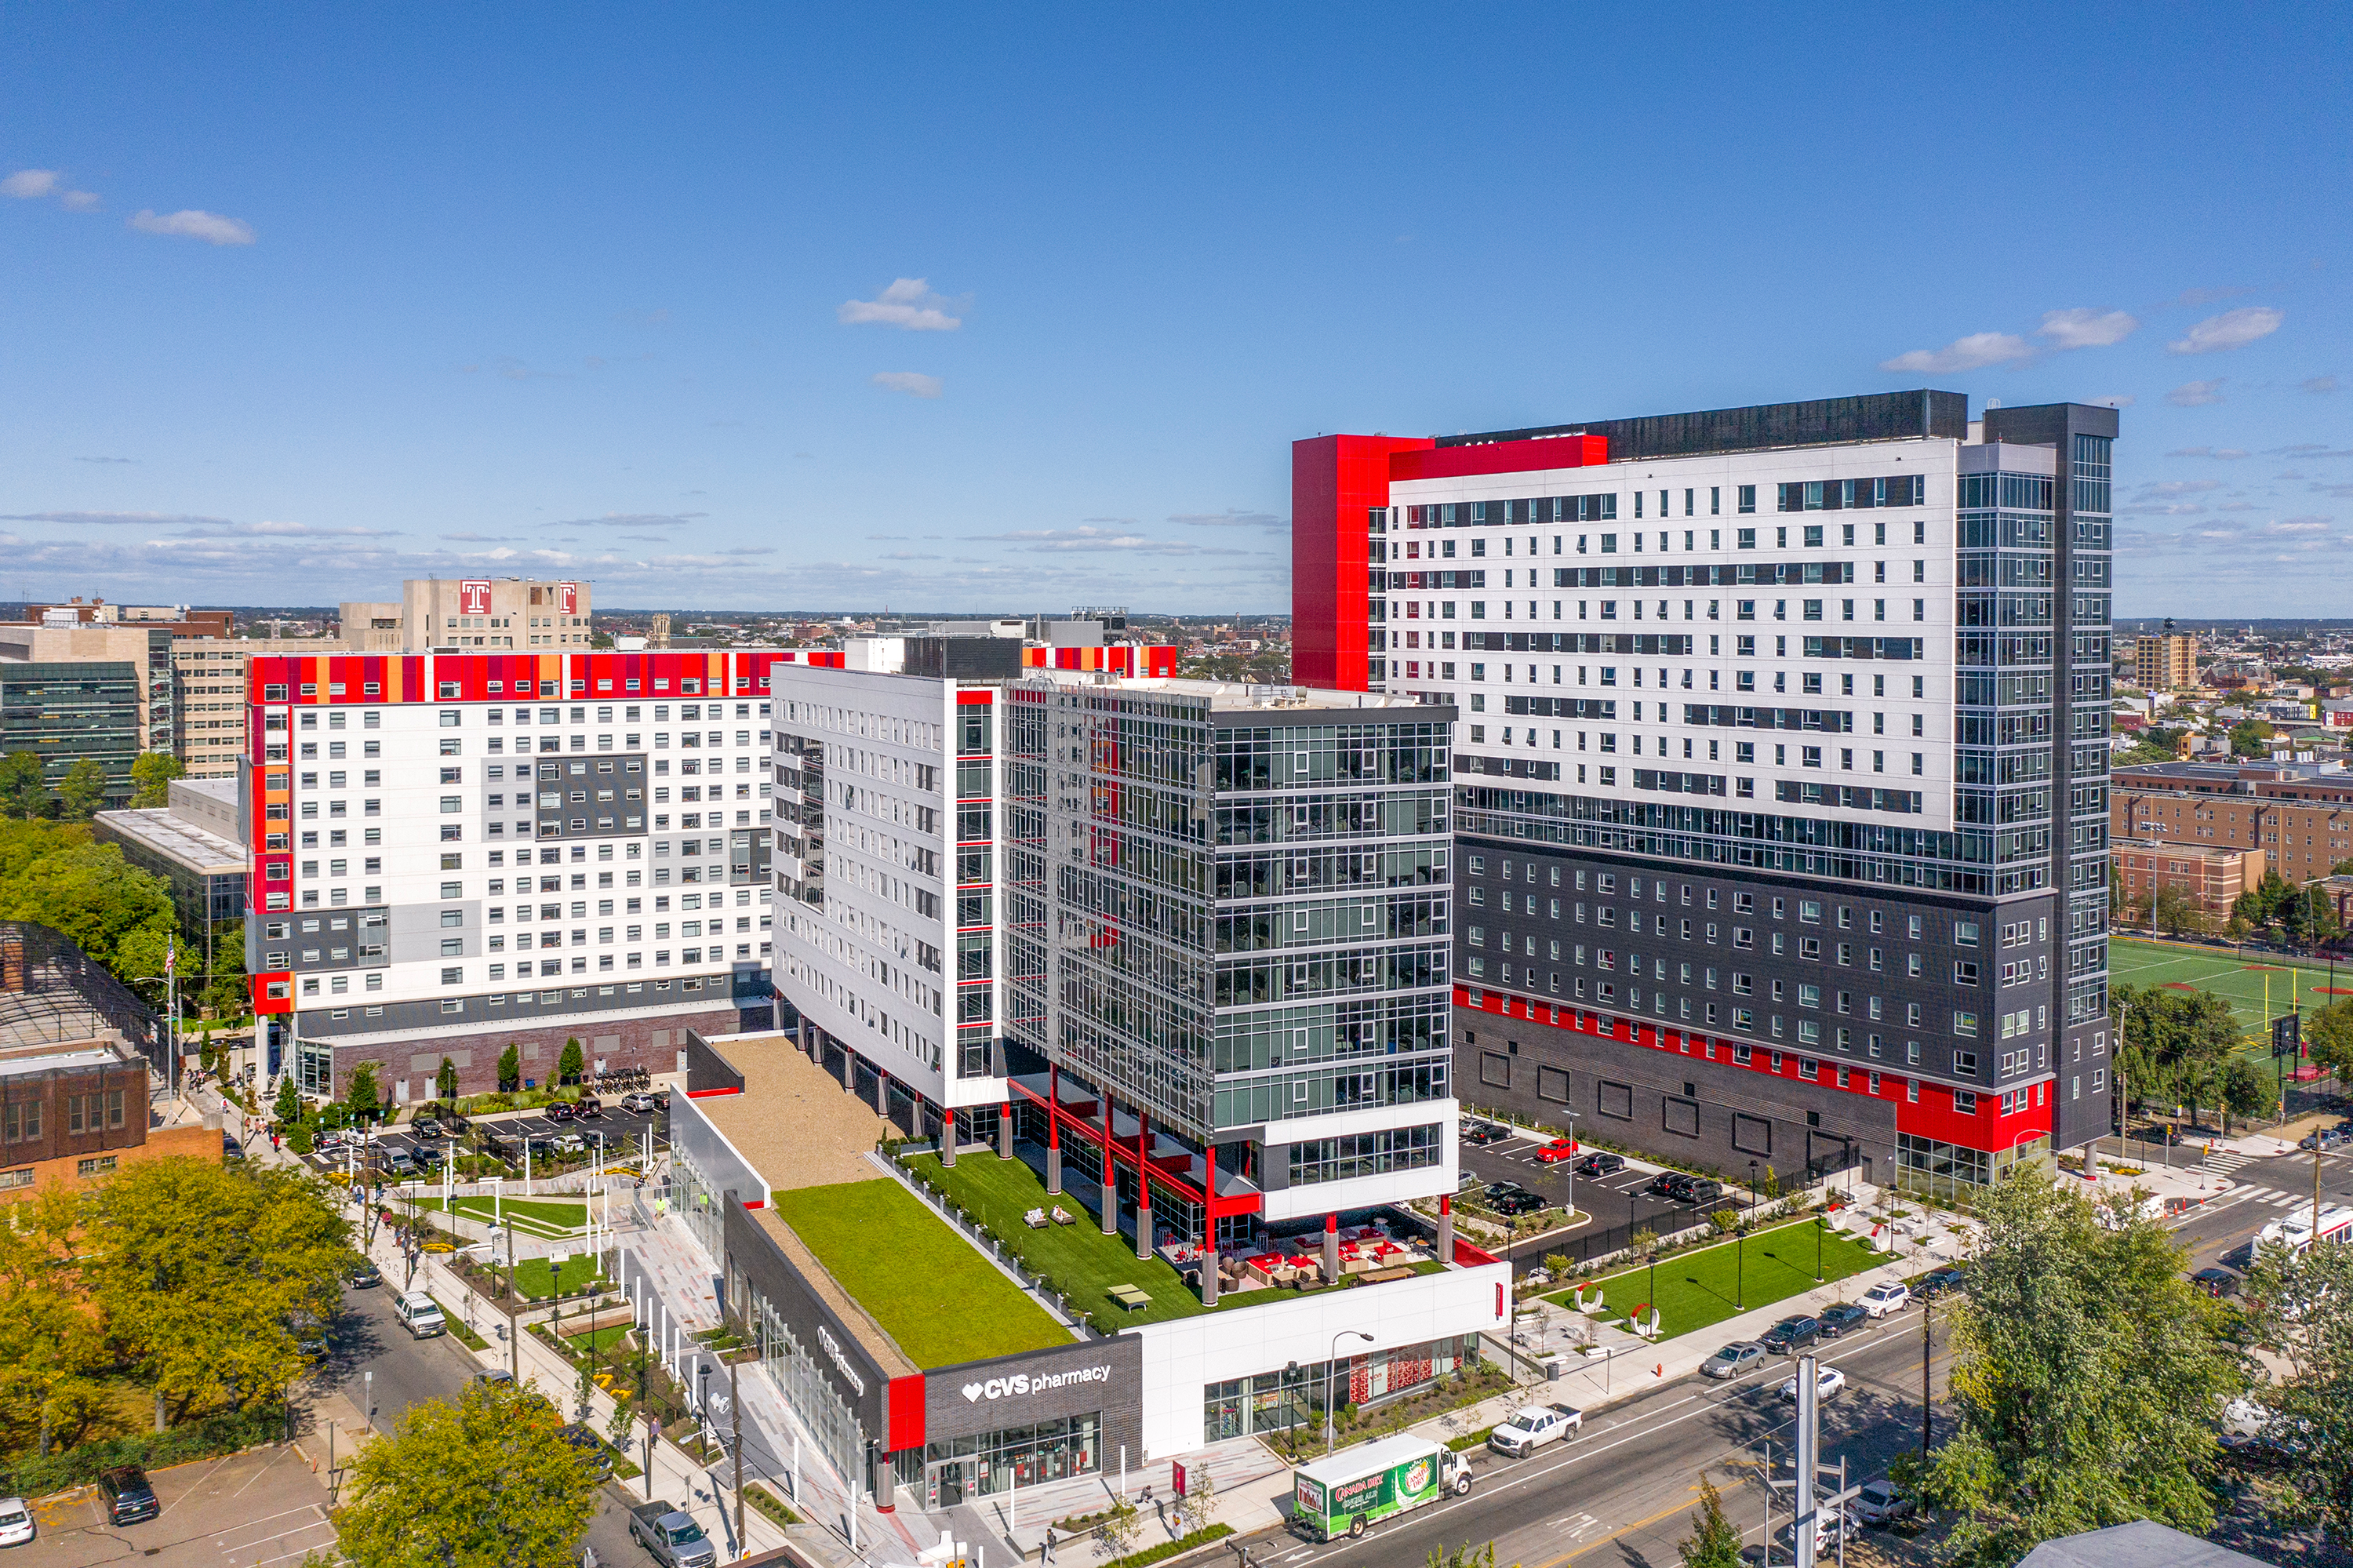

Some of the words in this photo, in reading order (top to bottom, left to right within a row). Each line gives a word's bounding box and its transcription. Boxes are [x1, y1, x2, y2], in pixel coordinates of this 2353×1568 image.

[462, 581, 489, 613] T
[984, 1374, 1030, 1400] CVS
[1031, 1365, 1111, 1395] pharmacy
[1336, 1480, 1367, 1502] CANADA
[1367, 1474, 1384, 1489] DRY
[1406, 1466, 1429, 1487] CANADA
[1413, 1476, 1424, 1488] DRY
